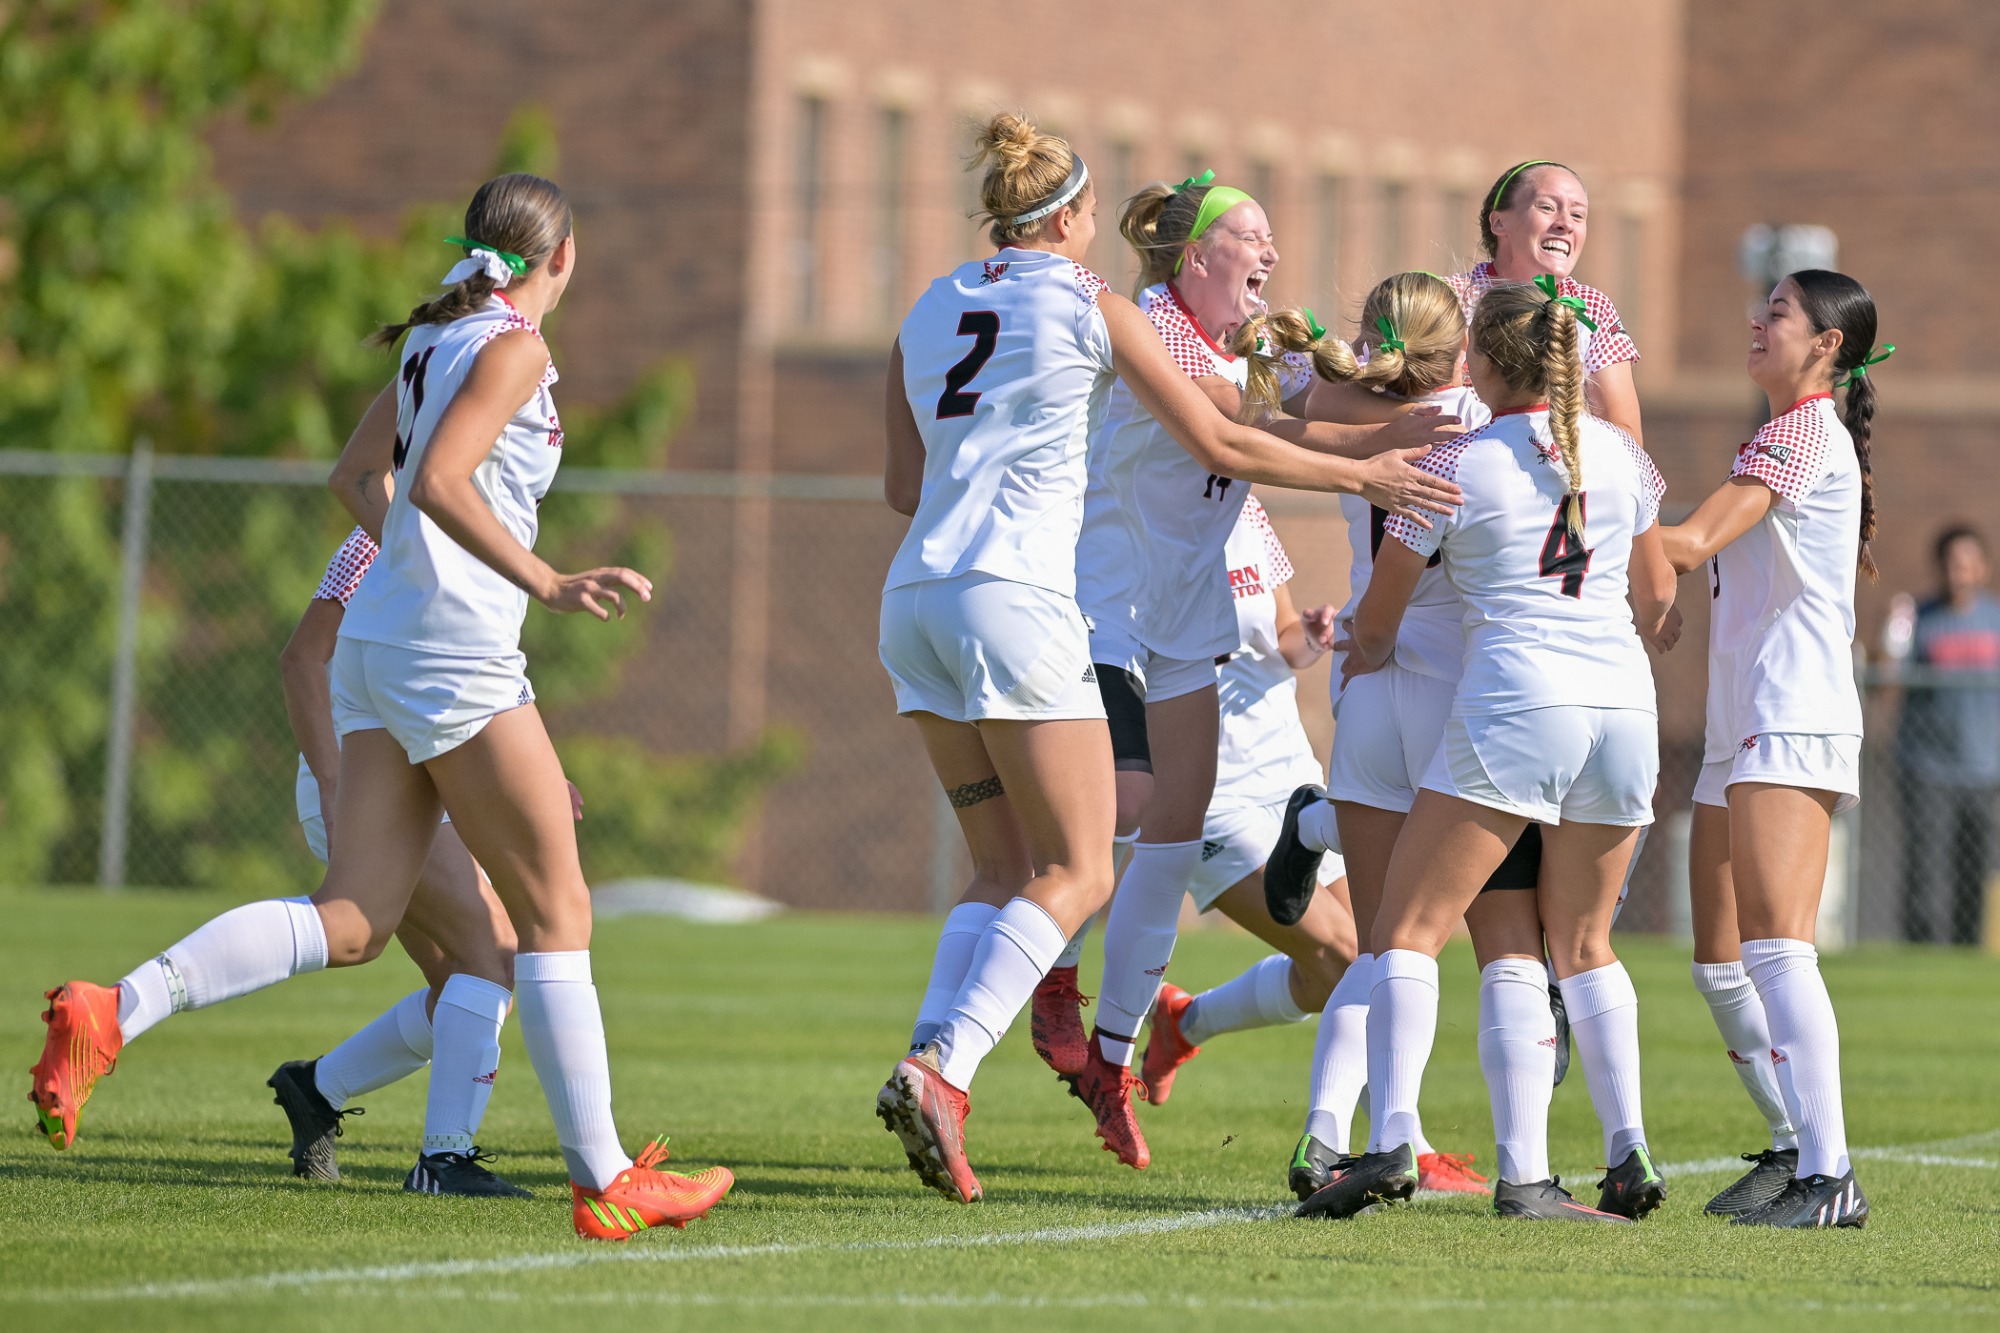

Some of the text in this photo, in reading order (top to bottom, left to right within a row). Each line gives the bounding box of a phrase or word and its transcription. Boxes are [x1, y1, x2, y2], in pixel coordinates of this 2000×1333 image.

[935, 310, 1001, 420] 2
[1769, 445, 1791, 460] SKY
[1538, 491, 1595, 600] 4
